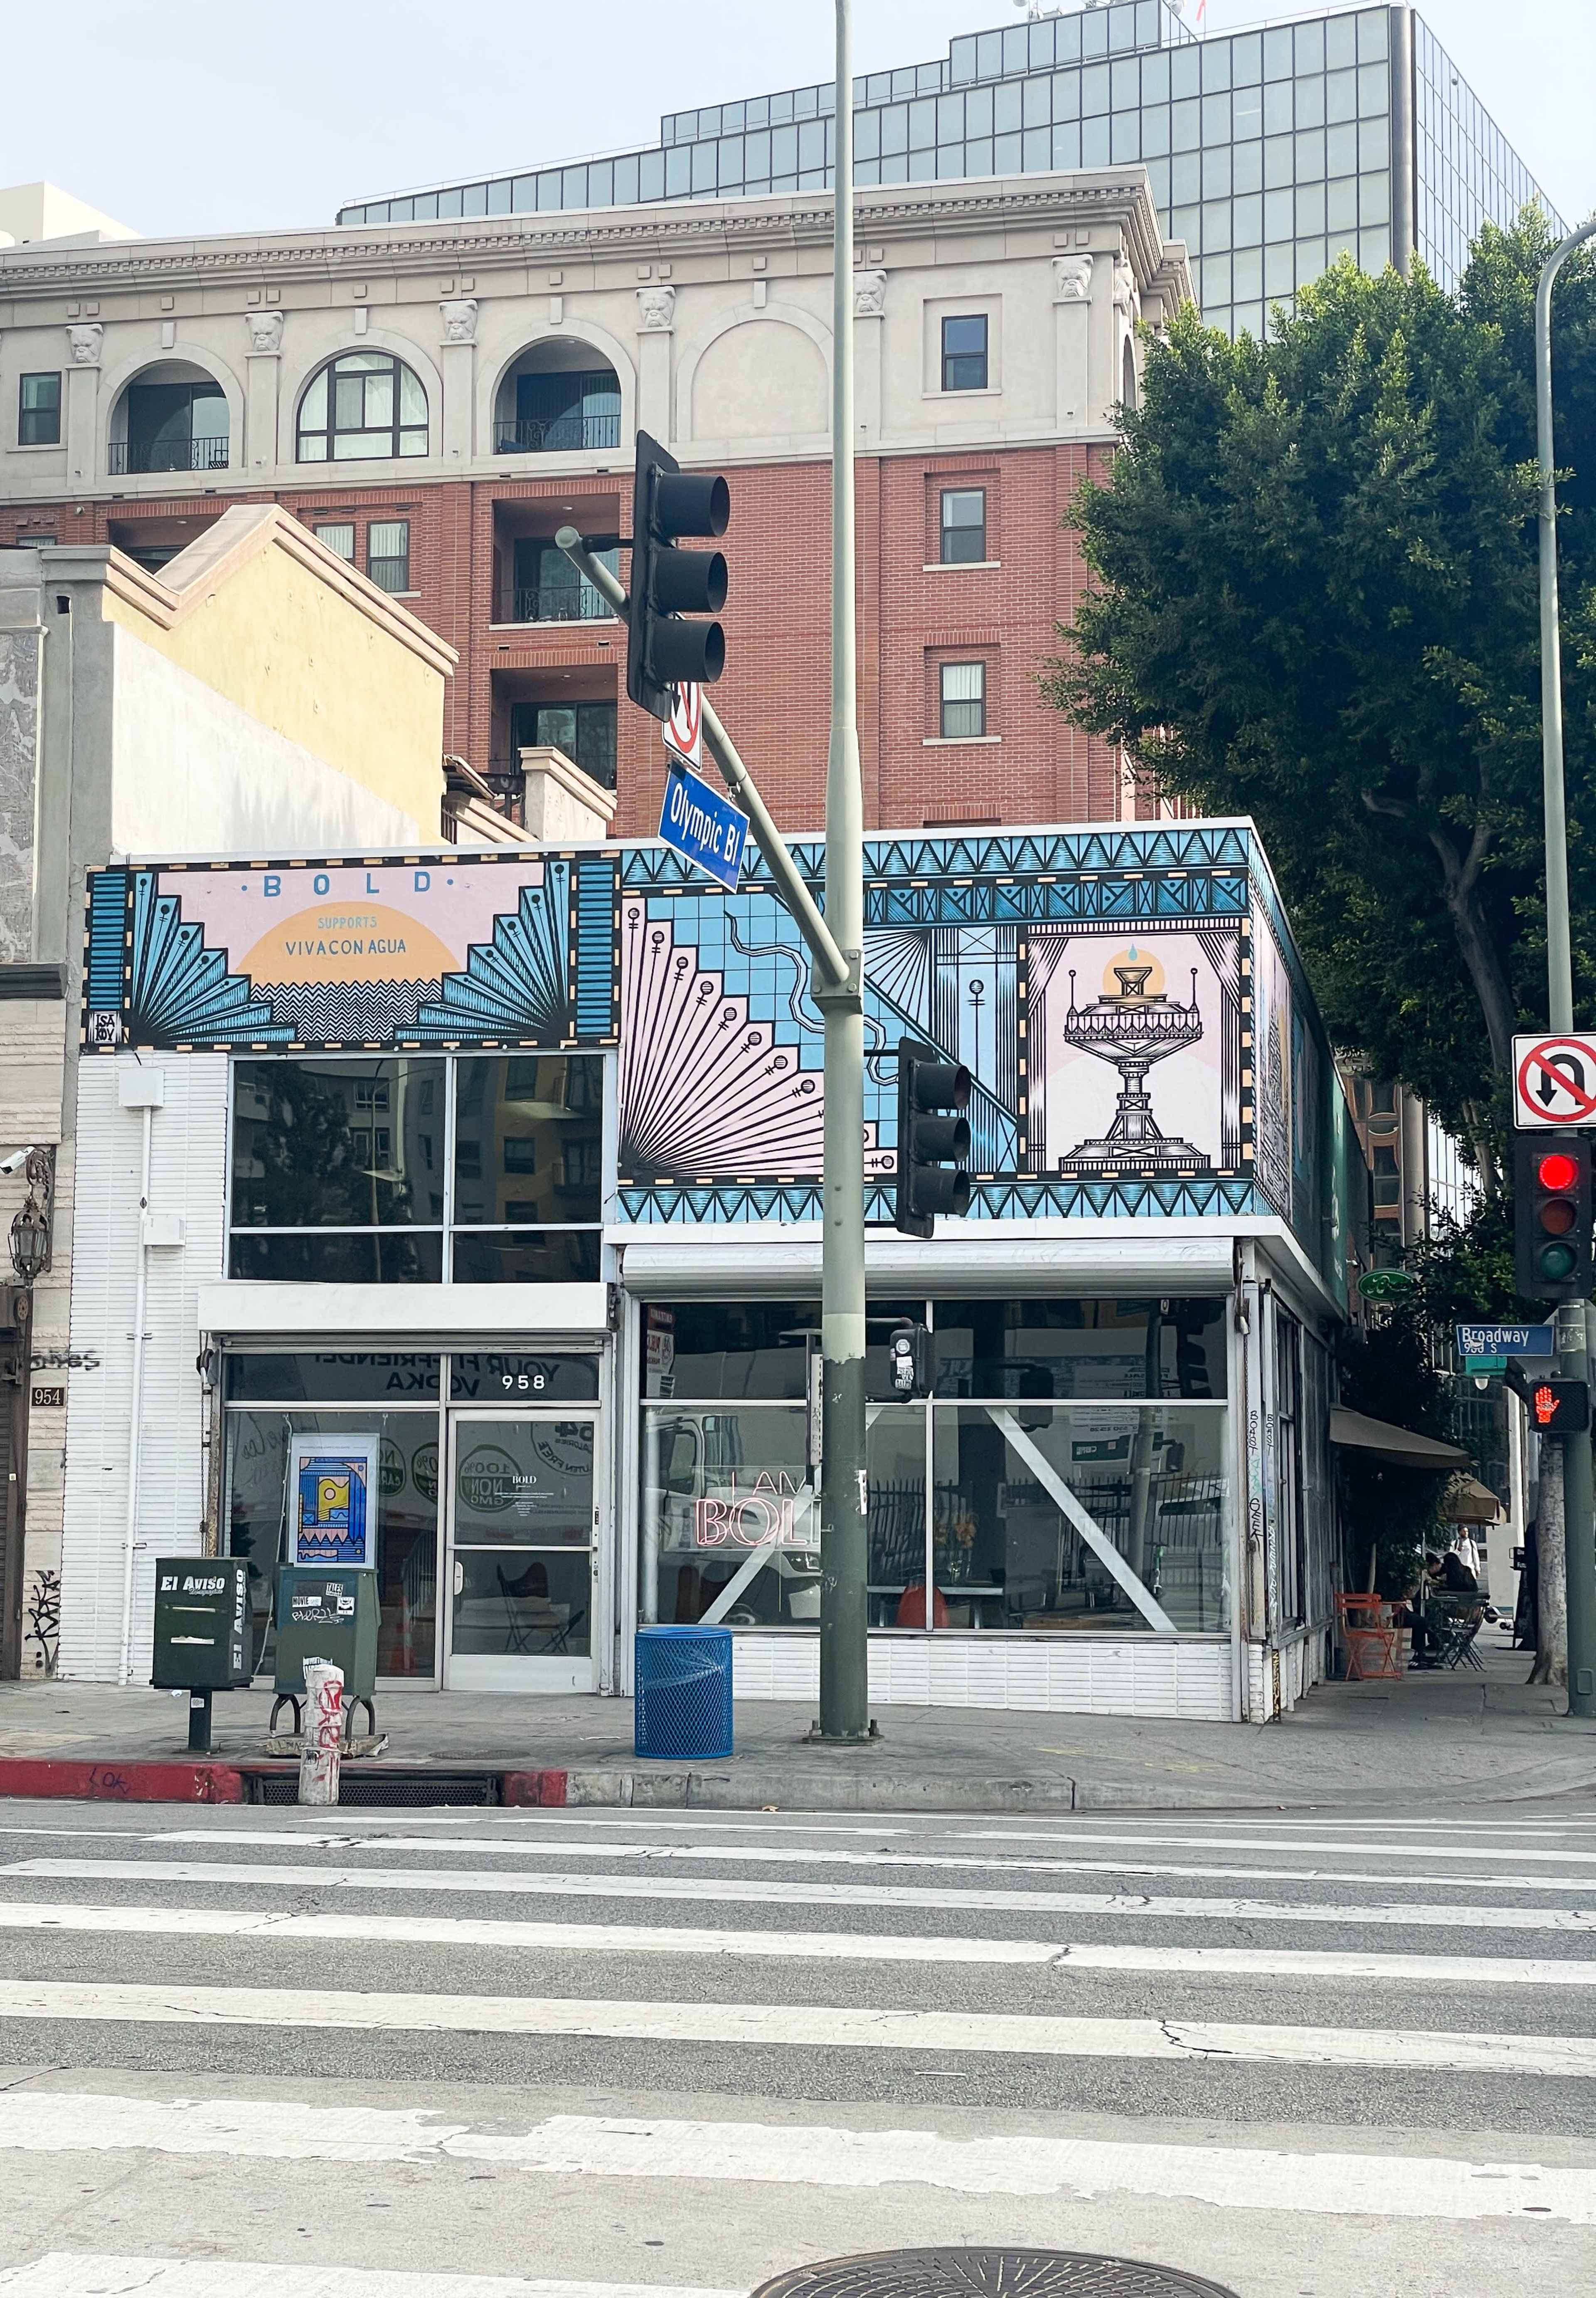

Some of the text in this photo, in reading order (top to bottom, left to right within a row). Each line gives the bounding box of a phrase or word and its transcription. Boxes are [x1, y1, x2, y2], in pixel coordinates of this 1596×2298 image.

[670, 782, 722, 853] Olympic
[318, 916, 377, 929] SUPPORTS
[368, 939, 406, 954] AGUA
[1462, 1328, 1529, 1347] Broadway
[1491, 1343, 1497, 1353] S
[502, 1374, 544, 1389] 958
[35, 1389, 60, 1404] 954
[160, 1576, 178, 1591] El
